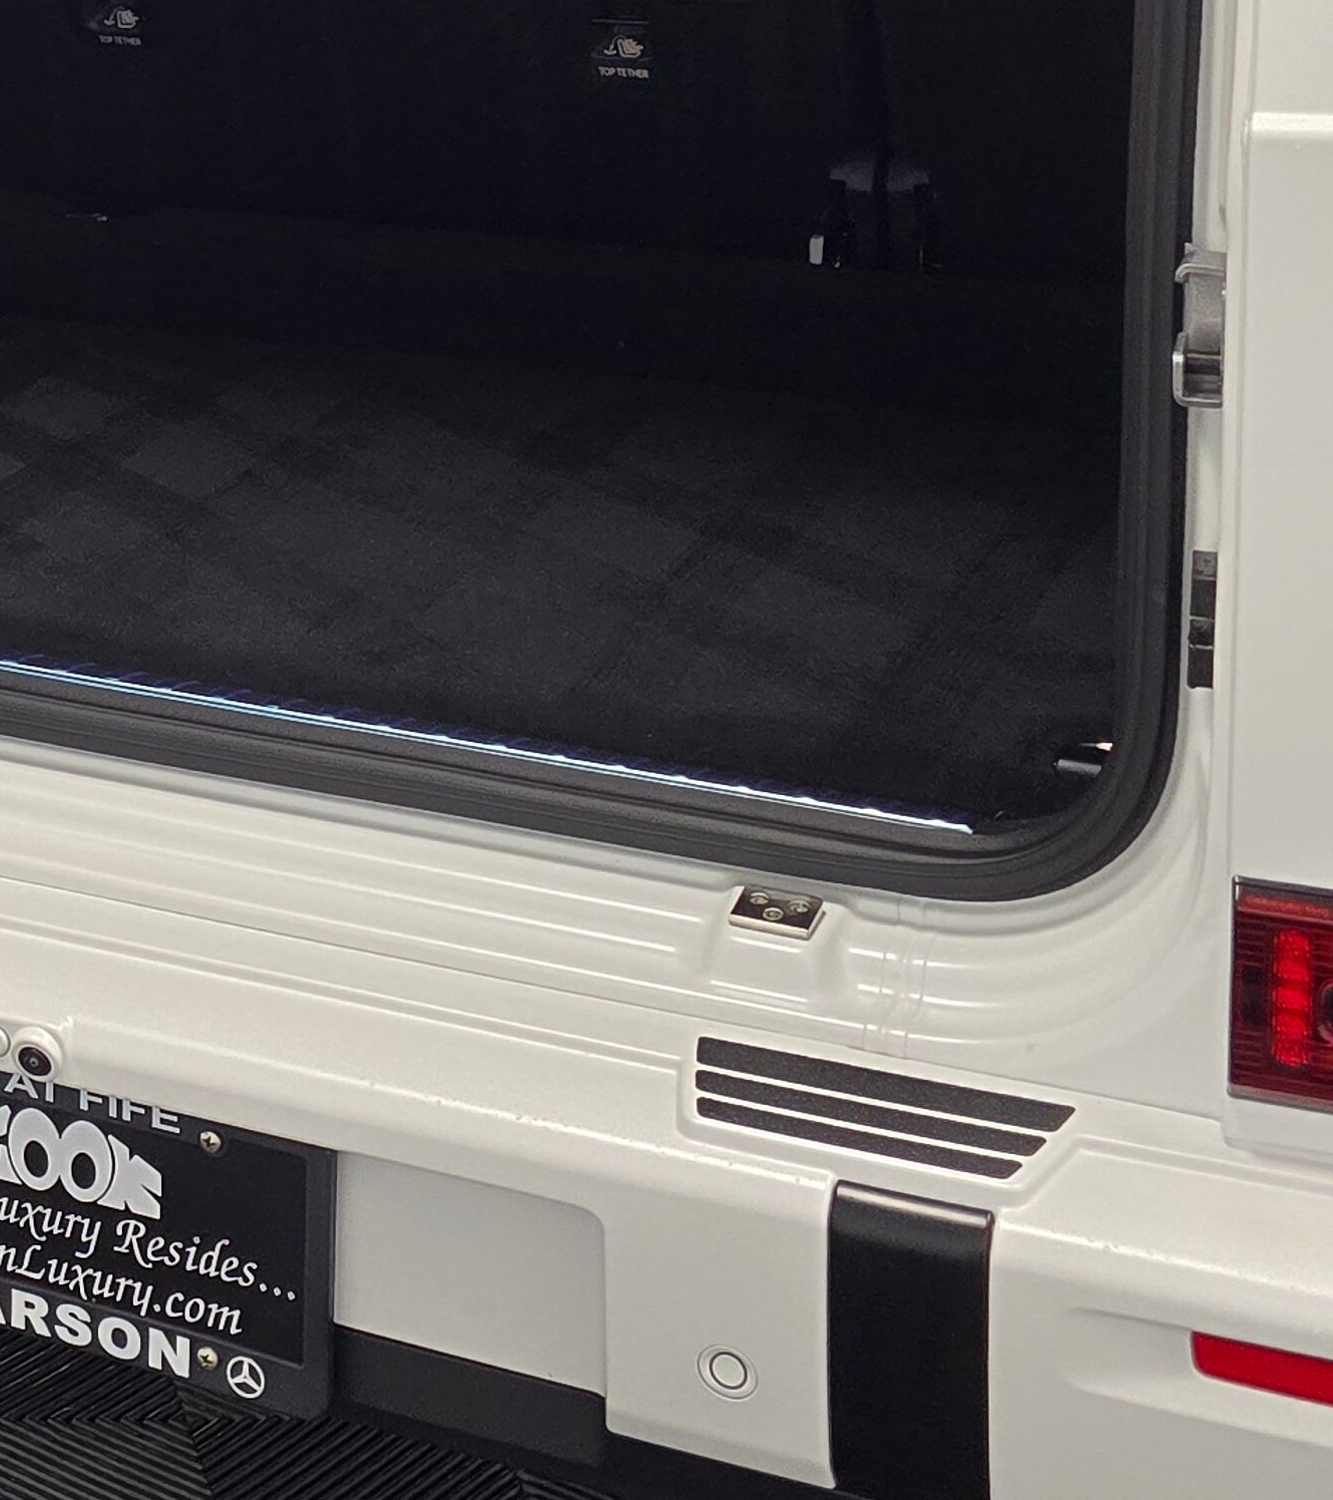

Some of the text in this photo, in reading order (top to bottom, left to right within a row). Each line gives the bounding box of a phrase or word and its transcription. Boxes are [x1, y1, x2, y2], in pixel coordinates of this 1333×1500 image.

[98, 34, 113, 44] TOP
[597, 65, 649, 79] TOP TETHER
[78, 1086, 181, 1134] FIFE
[112, 1218, 297, 1301] Resides...
